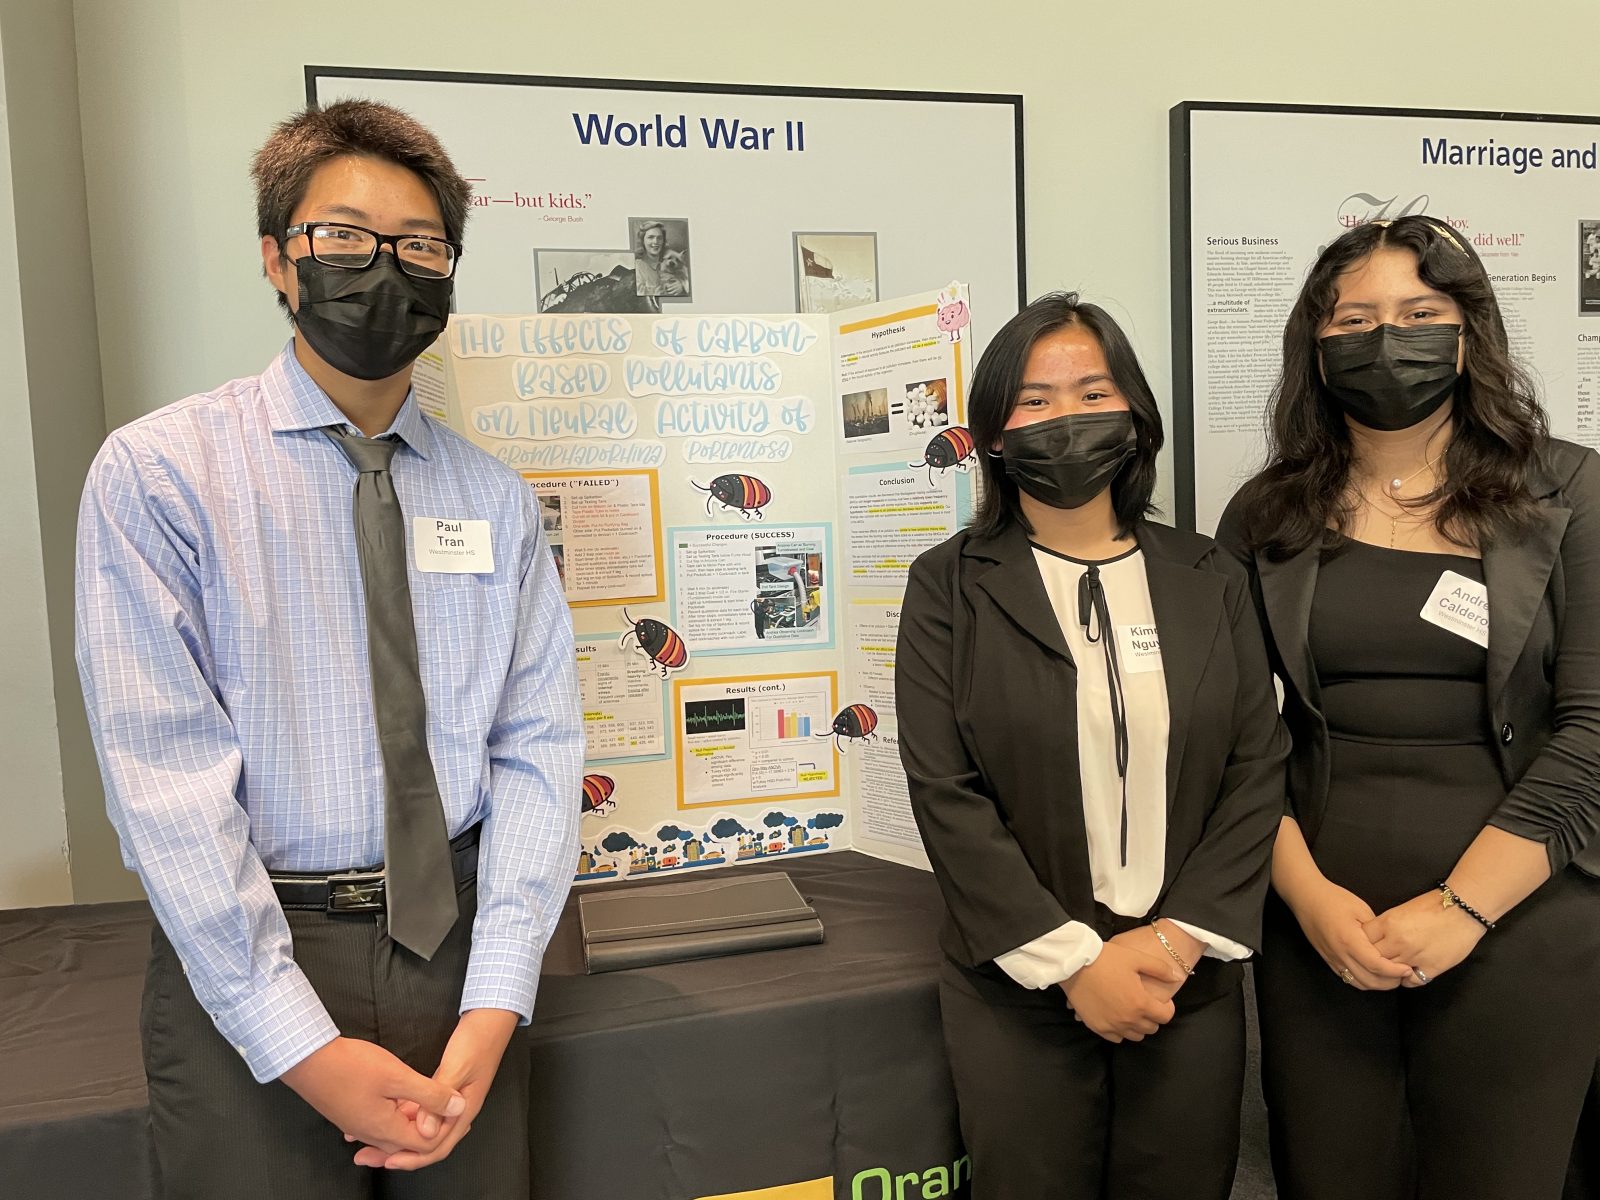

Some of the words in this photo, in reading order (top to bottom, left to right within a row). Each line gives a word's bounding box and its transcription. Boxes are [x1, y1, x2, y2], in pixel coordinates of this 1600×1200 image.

[572, 112, 687, 149] World
[700, 116, 775, 151] War
[786, 120, 804, 151] II
[1422, 137, 1543, 175] Marriage
[1551, 142, 1597, 169] and
[543, 215, 566, 223] George
[1207, 236, 1239, 246] Serious
[1241, 236, 1279, 246] Business
[1473, 233, 1493, 246] did
[1487, 273, 1529, 283] Generation
[1531, 273, 1557, 284] Begins
[871, 326, 906, 340] Hypothesis
[1577, 333, 1600, 343] Cham
[879, 477, 915, 486] Conclusion
[436, 520, 462, 533] Paul
[436, 535, 465, 547] Tran
[706, 532, 749, 541] Procedure
[751, 531, 795, 540] (SUCCESS)
[428, 548, 465, 556] Westminster
[1439, 597, 1489, 626] Caldero
[725, 686, 756, 695] Results
[758, 683, 787, 693] (cont.)
